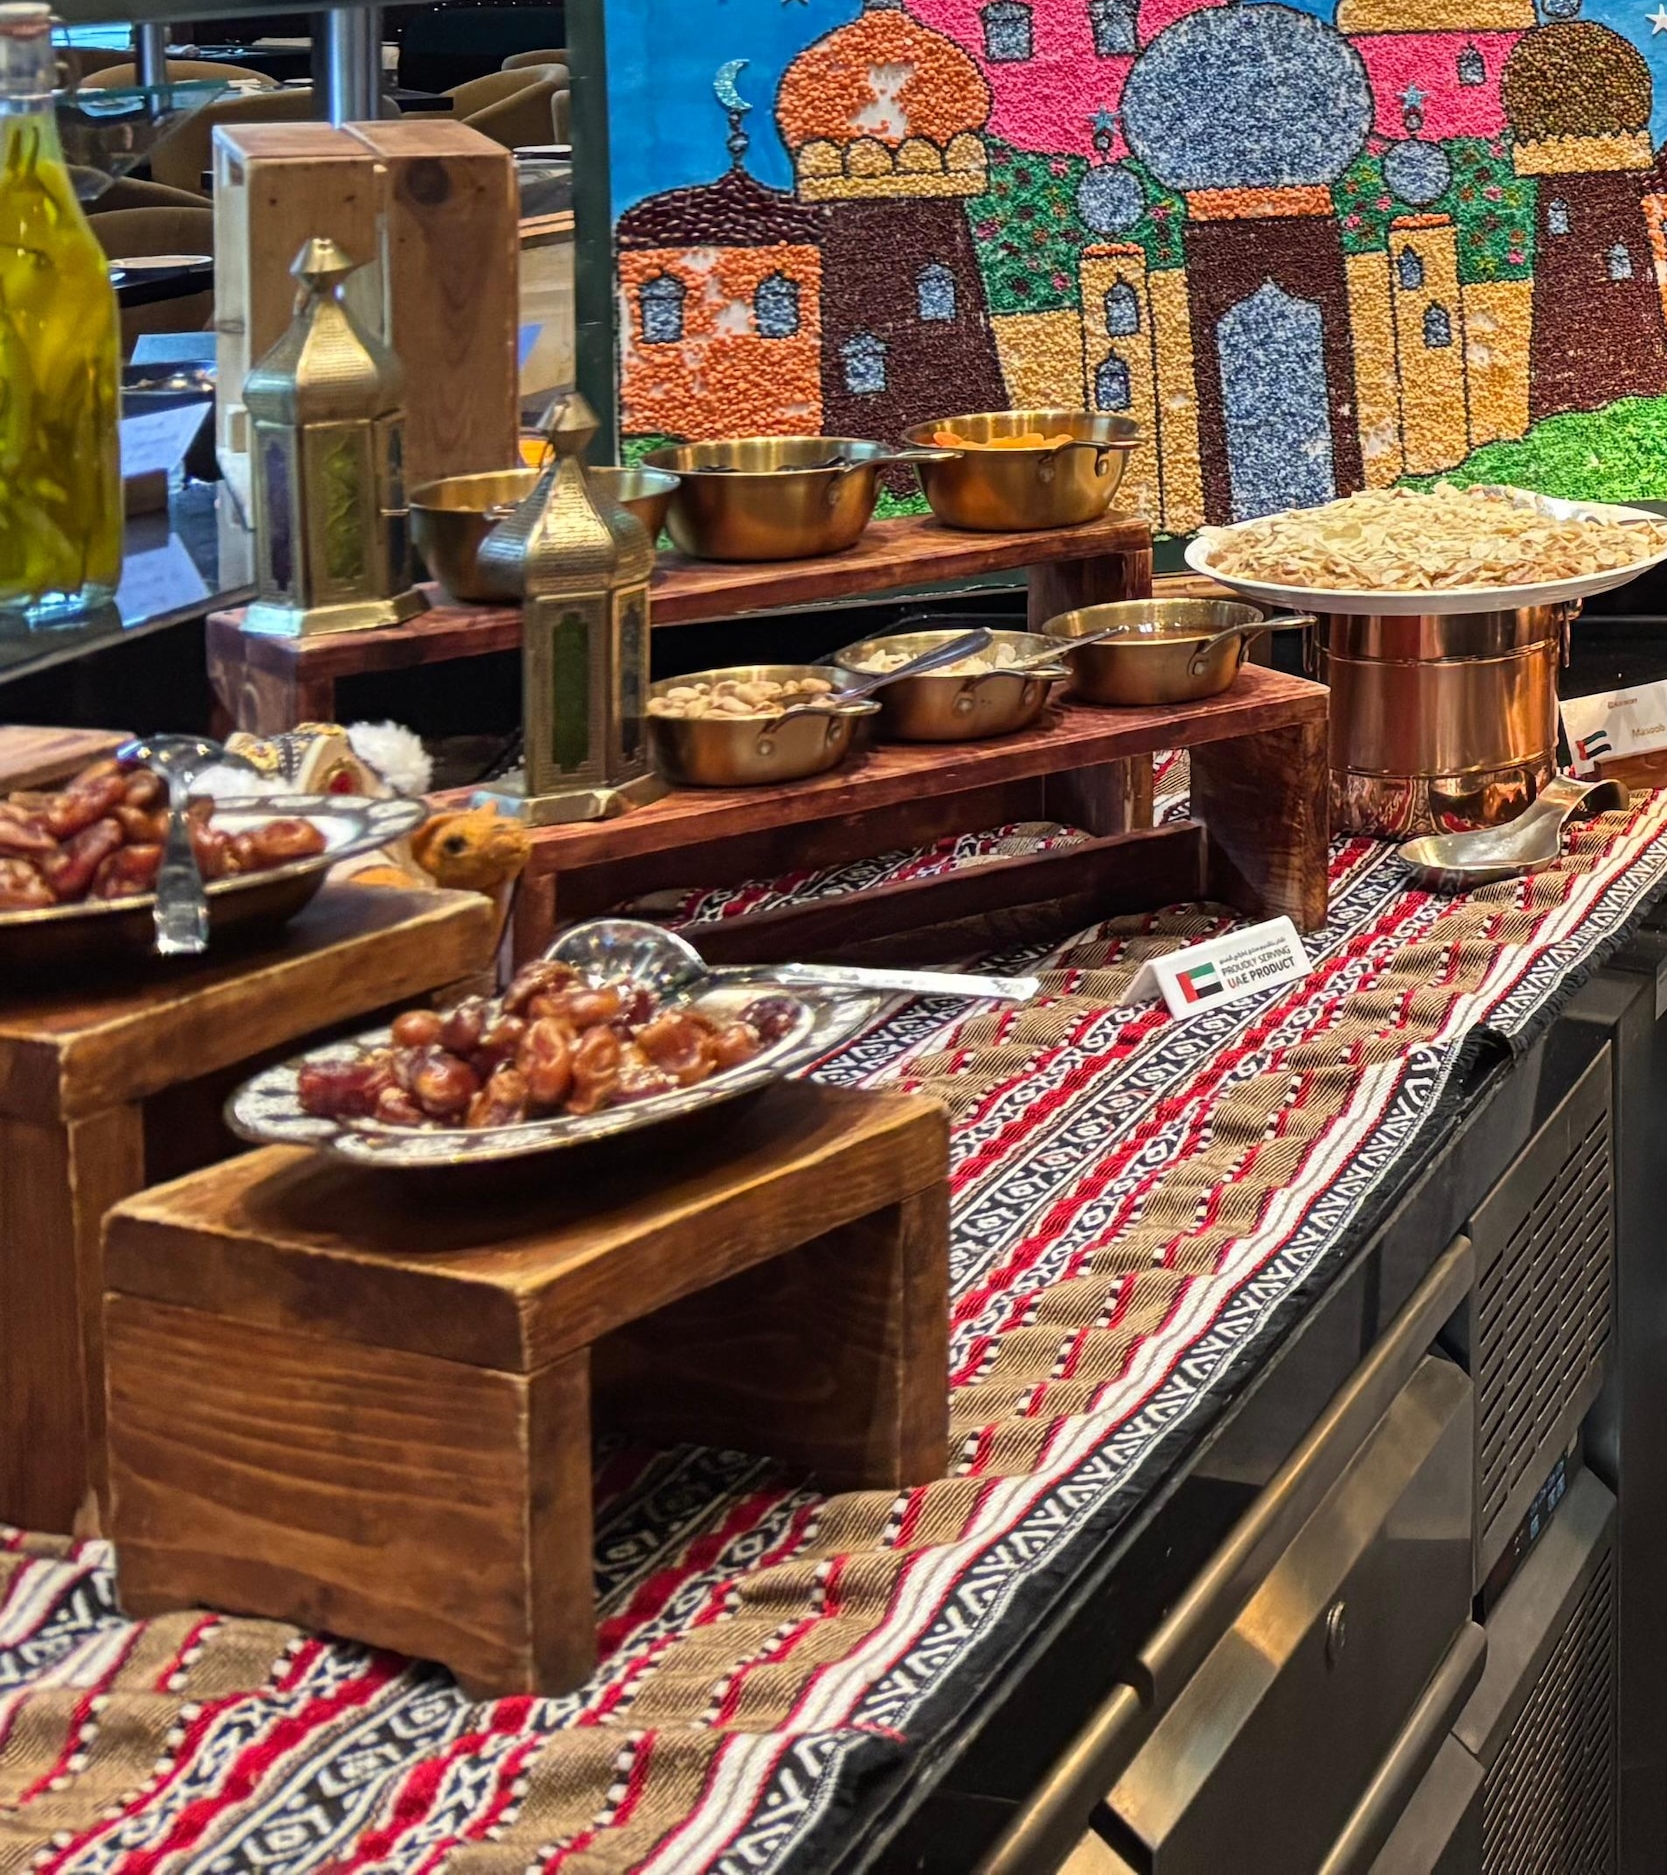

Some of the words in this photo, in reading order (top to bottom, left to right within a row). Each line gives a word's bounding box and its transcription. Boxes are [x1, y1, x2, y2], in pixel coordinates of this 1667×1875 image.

[1221, 957, 1258, 977] PROUDLY
[1257, 945, 1292, 964] SERVING
[1227, 972, 1250, 989] UAE
[1248, 955, 1296, 981] PRODUCT
